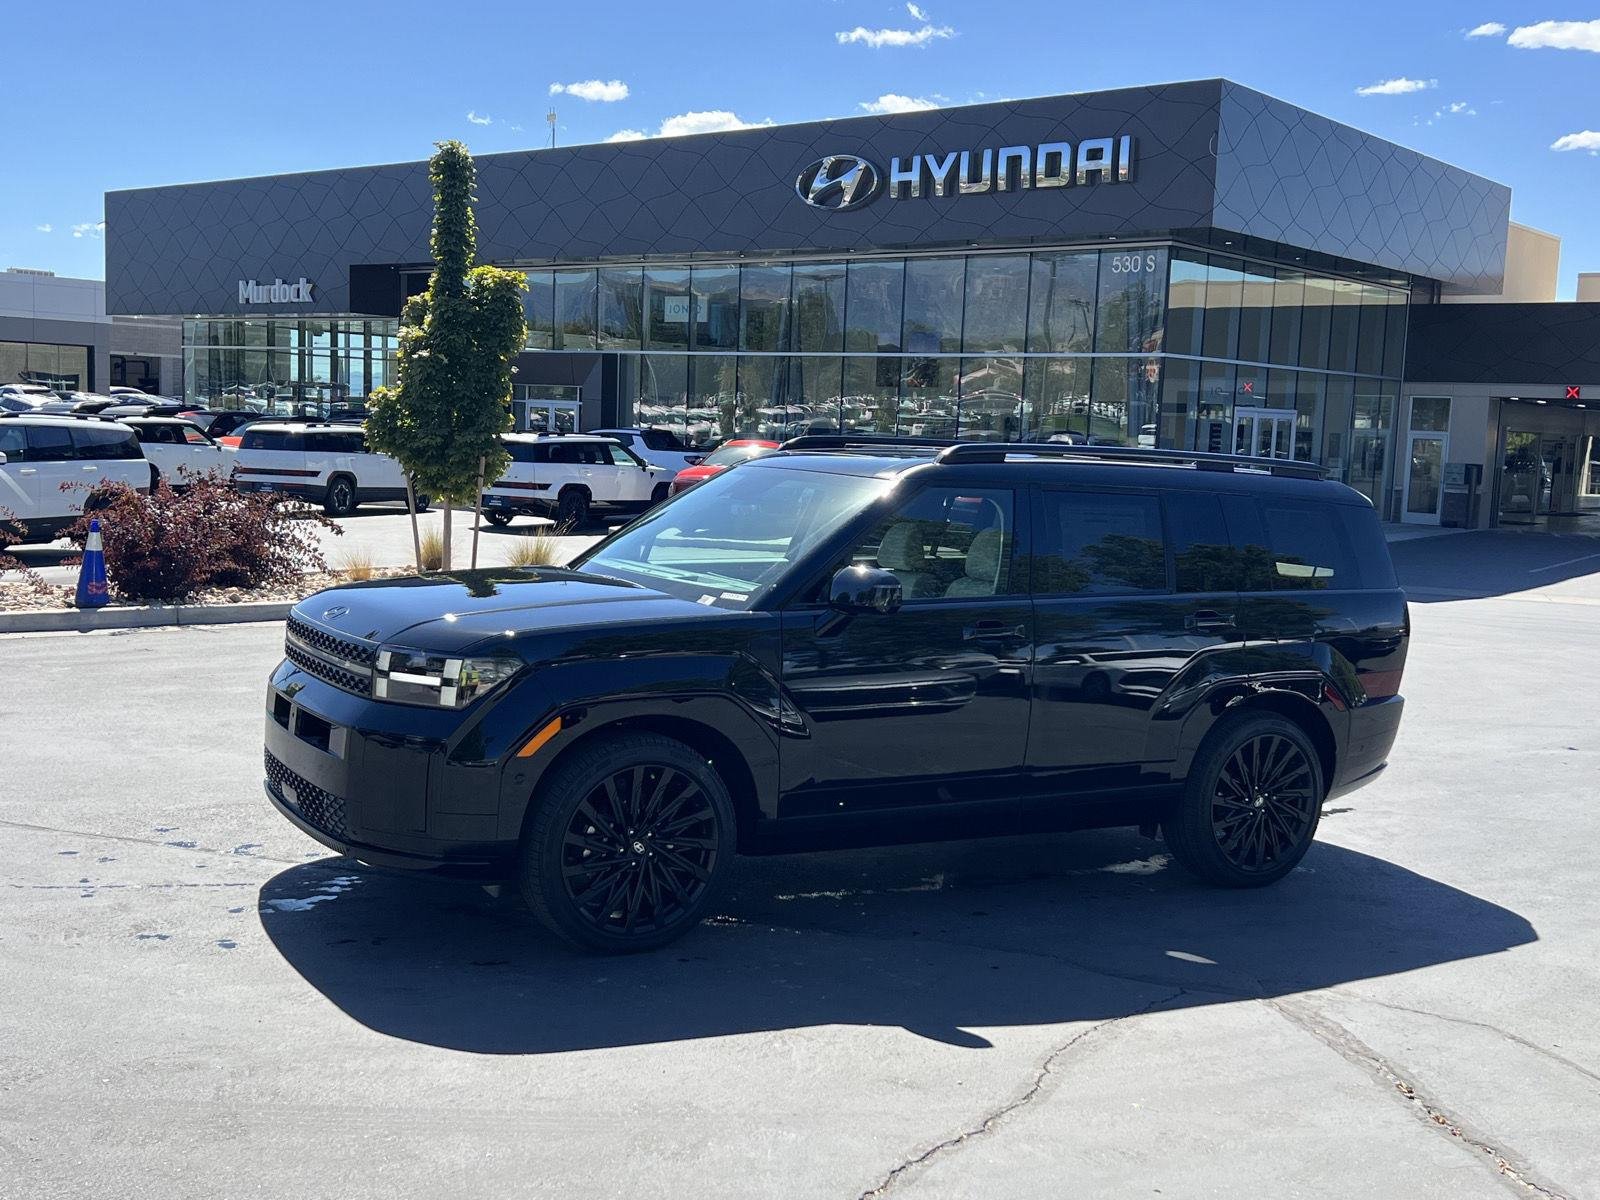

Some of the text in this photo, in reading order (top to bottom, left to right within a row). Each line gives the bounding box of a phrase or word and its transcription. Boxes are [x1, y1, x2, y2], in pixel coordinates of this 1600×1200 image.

[889, 135, 1132, 199] HYUNDAI
[1112, 255, 1155, 273] 530 S
[238, 277, 314, 304] Murdock
